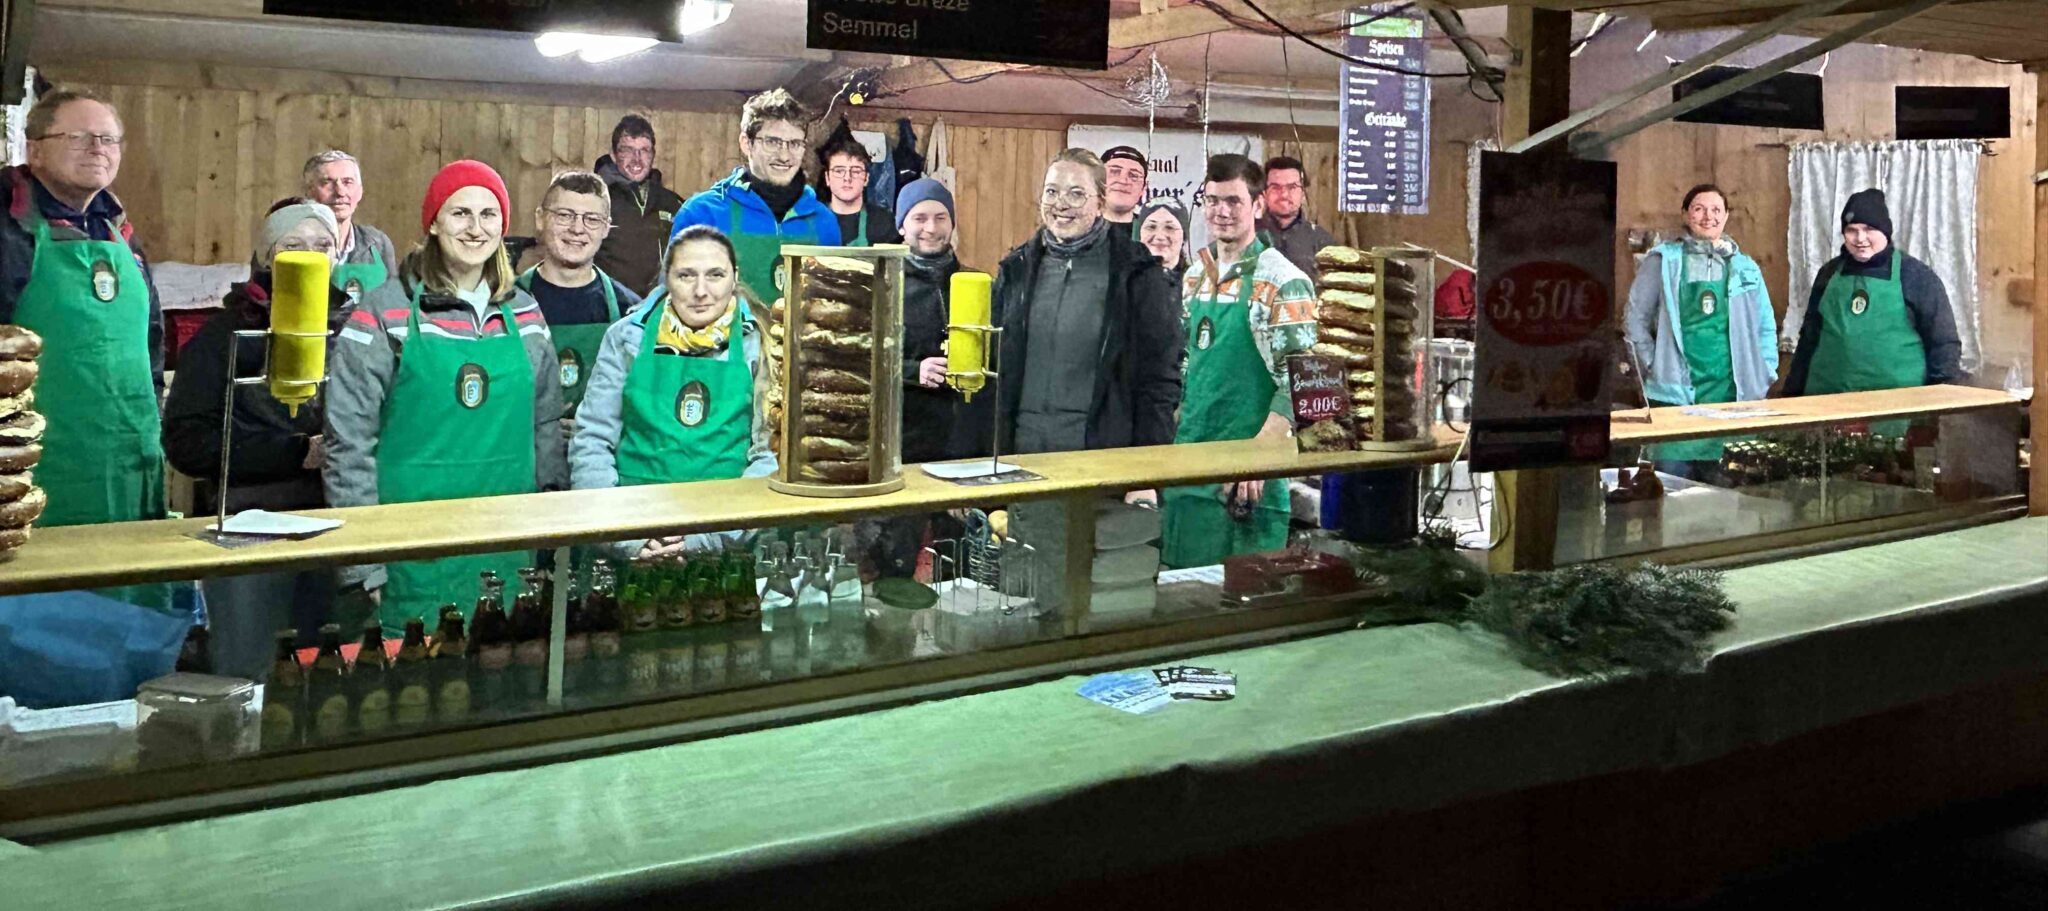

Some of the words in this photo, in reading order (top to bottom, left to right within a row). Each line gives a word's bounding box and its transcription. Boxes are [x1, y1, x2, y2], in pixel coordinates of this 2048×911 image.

[823, 11, 917, 39] Semmel
[1369, 39, 1404, 56] Speisen
[1364, 112, 1407, 128] Getränke
[1491, 278, 1597, 328] 3,50€
[1298, 396, 1341, 415] 2,00€
